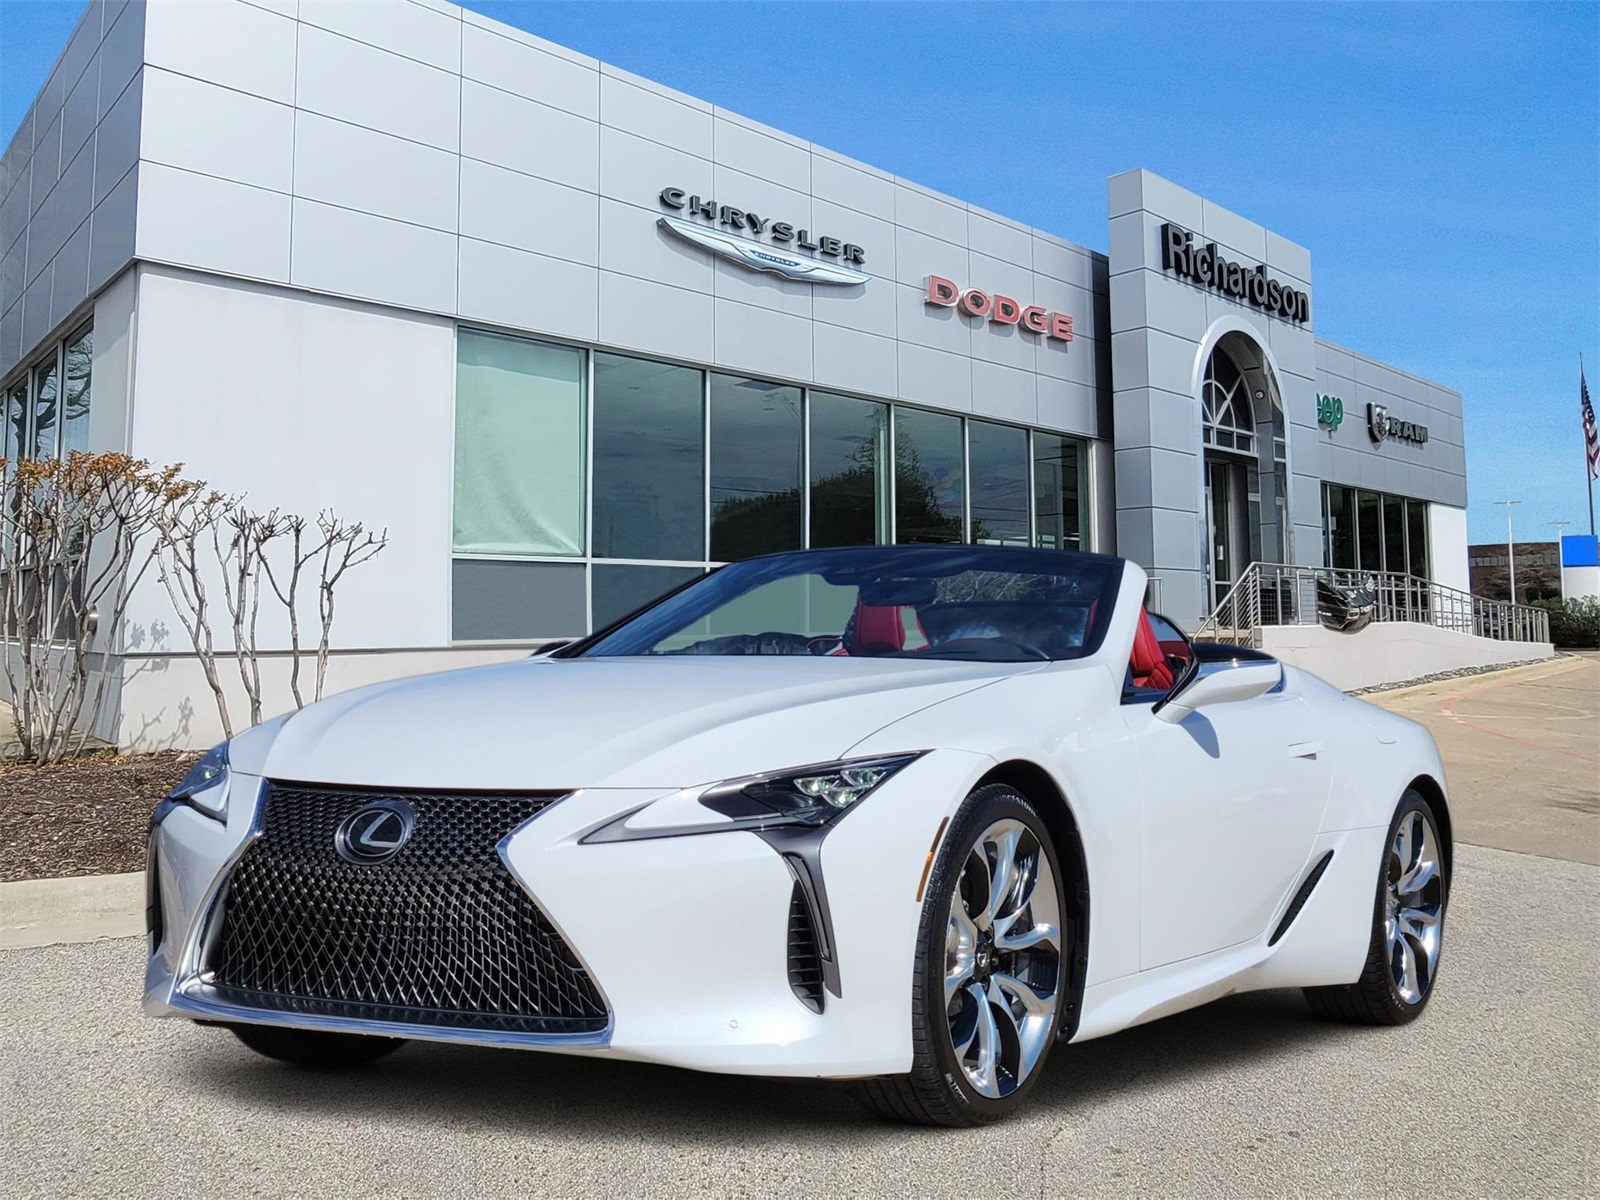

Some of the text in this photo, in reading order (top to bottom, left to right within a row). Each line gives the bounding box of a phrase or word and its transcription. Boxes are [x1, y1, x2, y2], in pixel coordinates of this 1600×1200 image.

[659, 186, 866, 264] CHRYSLER
[923, 274, 1074, 342] DODGE
[1161, 223, 1309, 323] Richardson
[1388, 416, 1429, 443] RAM
